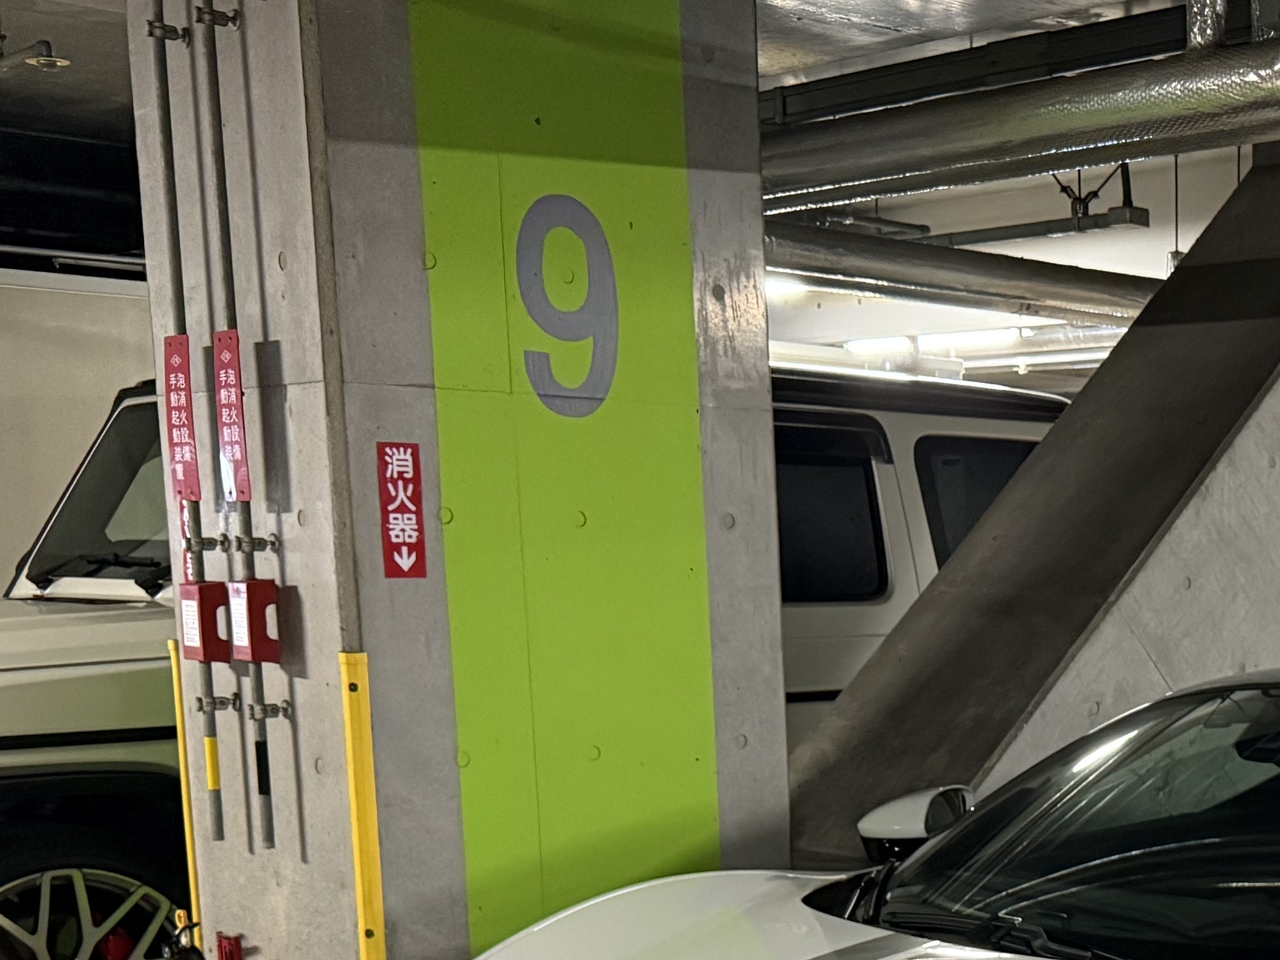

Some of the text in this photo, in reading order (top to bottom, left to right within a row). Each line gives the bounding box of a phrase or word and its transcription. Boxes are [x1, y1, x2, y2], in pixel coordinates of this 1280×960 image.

[516, 194, 619, 418] 9
[384, 446, 420, 543] 消火器
